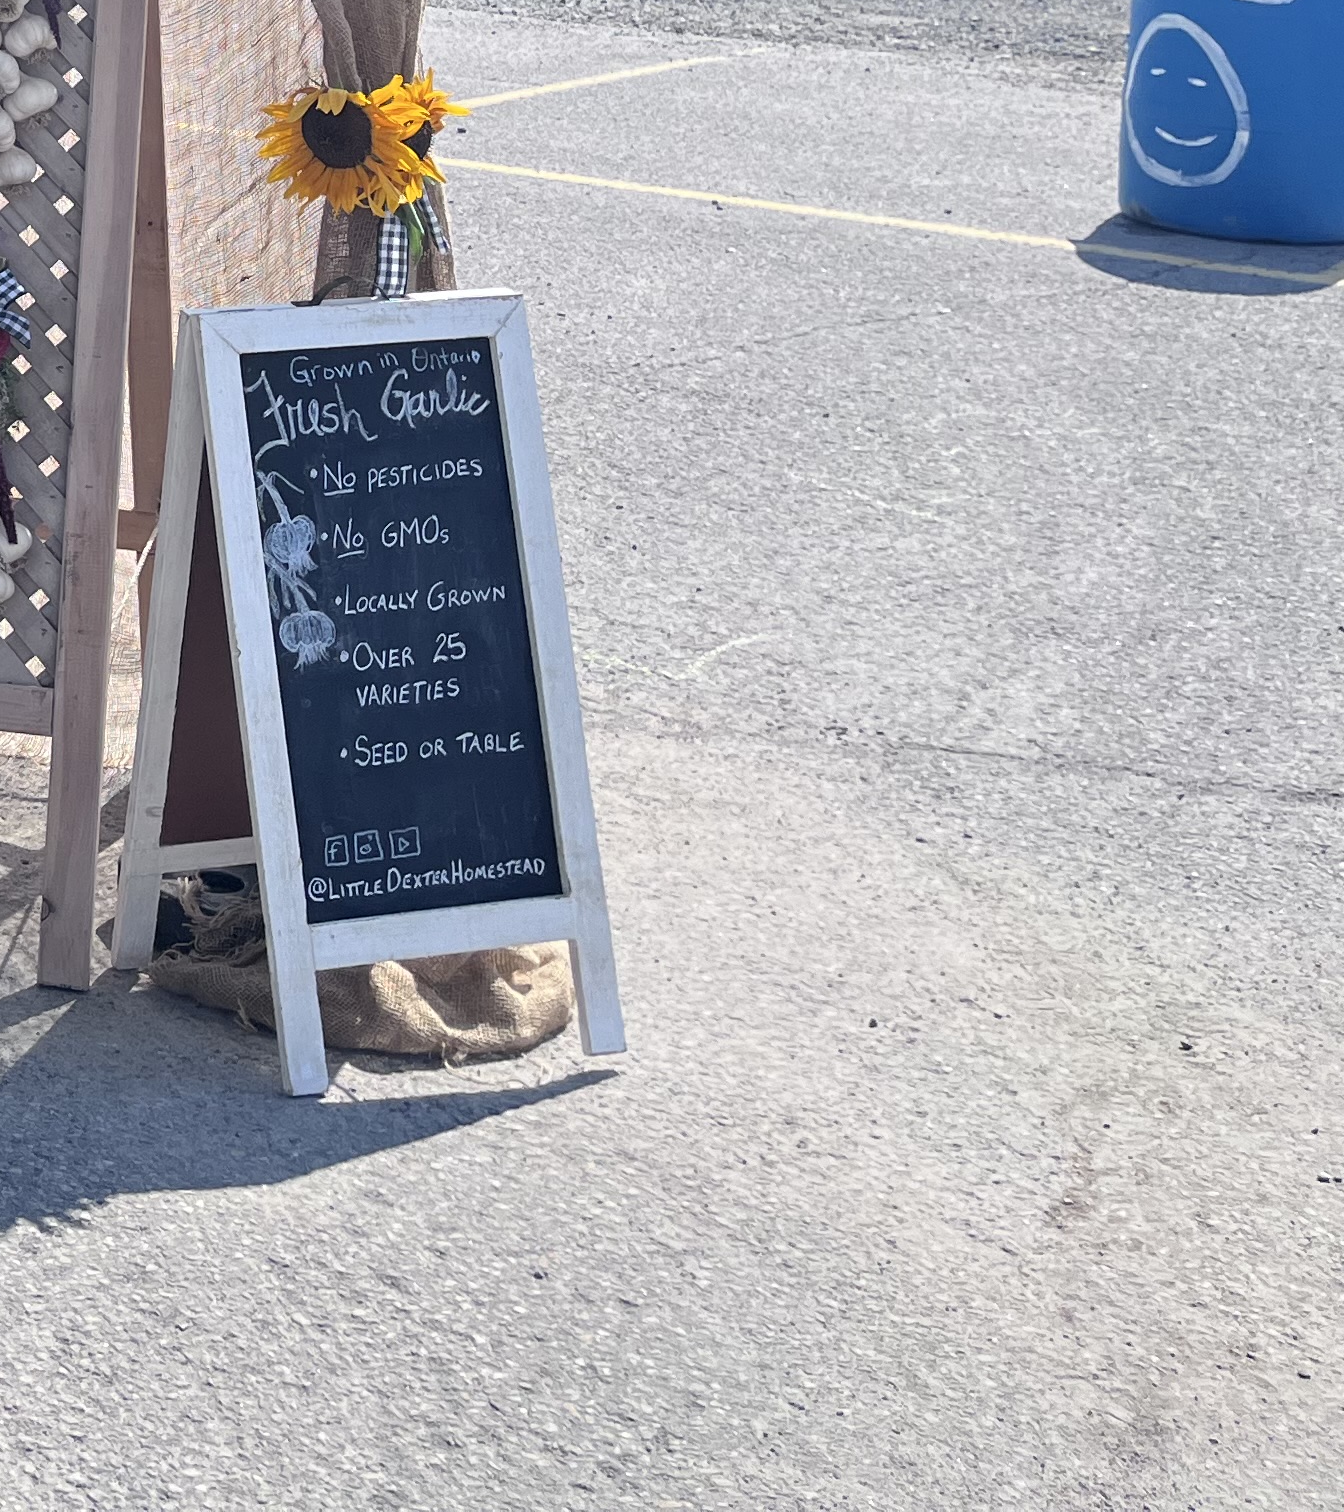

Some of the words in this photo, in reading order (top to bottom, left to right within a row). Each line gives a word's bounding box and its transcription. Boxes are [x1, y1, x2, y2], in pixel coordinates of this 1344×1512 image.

[289, 356, 373, 387] Grown
[377, 351, 399, 369] in
[412, 346, 481, 373] Ontario
[245, 370, 378, 453] Fresh
[380, 367, 490, 428] Garlic
[367, 459, 483, 493] PESTICIDES
[343, 583, 419, 615] LOCALLY
[426, 580, 506, 612] GROWN
[352, 641, 415, 672] OVER
[432, 632, 467, 663] 25
[355, 678, 461, 707] VARIETIES
[354, 735, 409, 767] SEED
[419, 738, 447, 760] OR
[455, 731, 526, 755] TABLE
